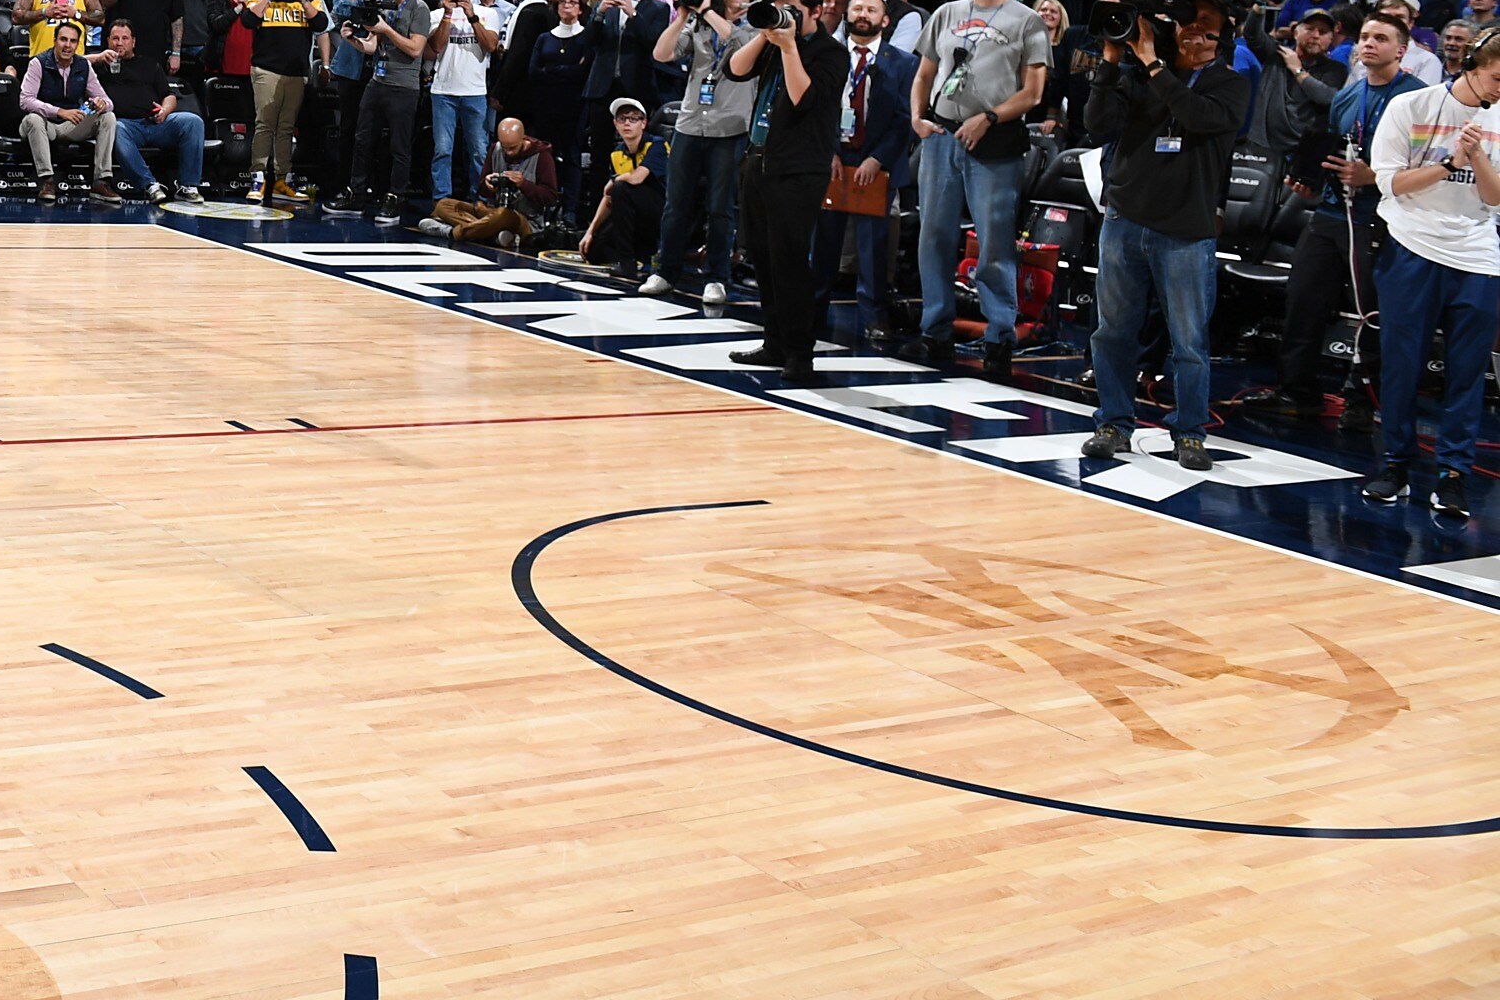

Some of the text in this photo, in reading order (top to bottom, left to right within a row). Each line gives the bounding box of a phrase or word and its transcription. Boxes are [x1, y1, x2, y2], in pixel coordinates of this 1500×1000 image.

[263, 7, 307, 23] LAKE
[449, 36, 479, 46] NUGGETS
[8, 180, 38, 188] LEXUS
[1230, 177, 1259, 186] LEXUS
[244, 241, 1365, 502] DENVER
